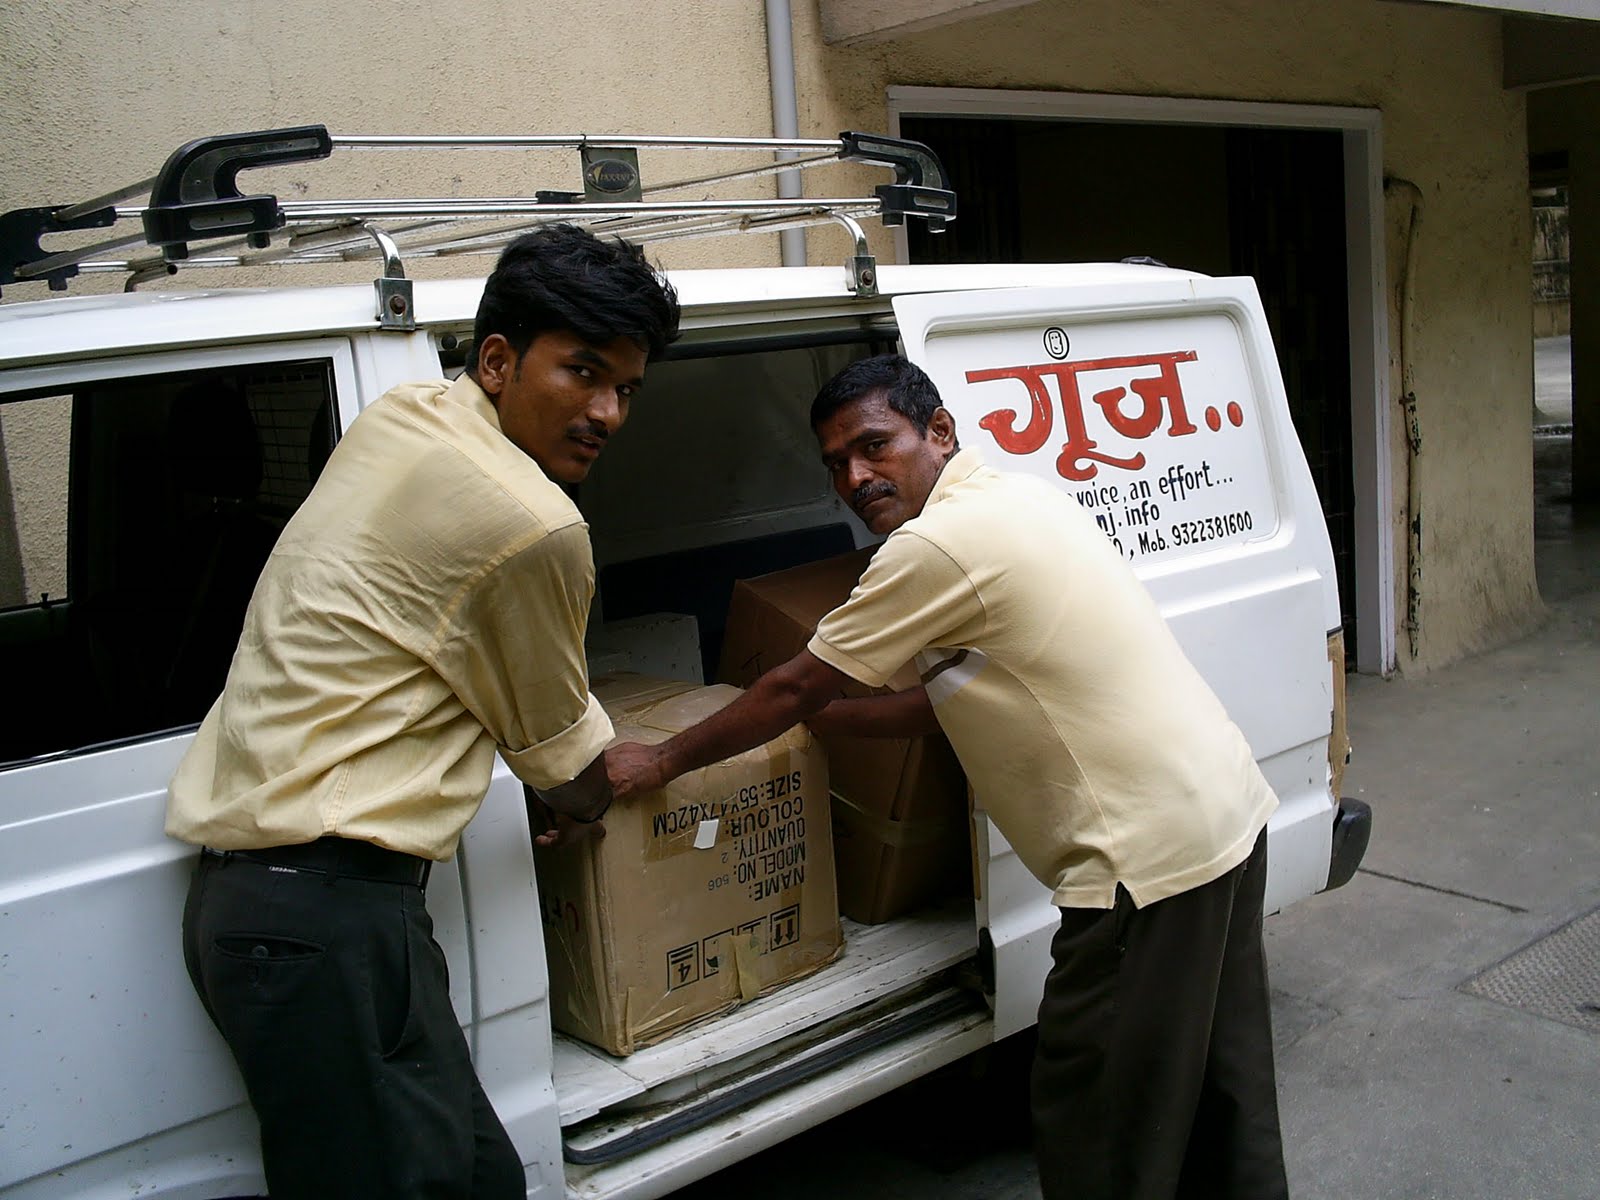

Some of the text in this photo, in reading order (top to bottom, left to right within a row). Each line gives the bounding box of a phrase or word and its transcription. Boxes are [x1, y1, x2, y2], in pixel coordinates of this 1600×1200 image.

[1138, 529, 1170, 555] Mob.
[1171, 510, 1253, 547] 9322381600
[724, 796, 804, 837] COLOUR:
[733, 817, 806, 860] QUANTITY:
[733, 861, 756, 884] NO:
[759, 841, 806, 876] MODEL
[748, 864, 805, 902] NAME:
